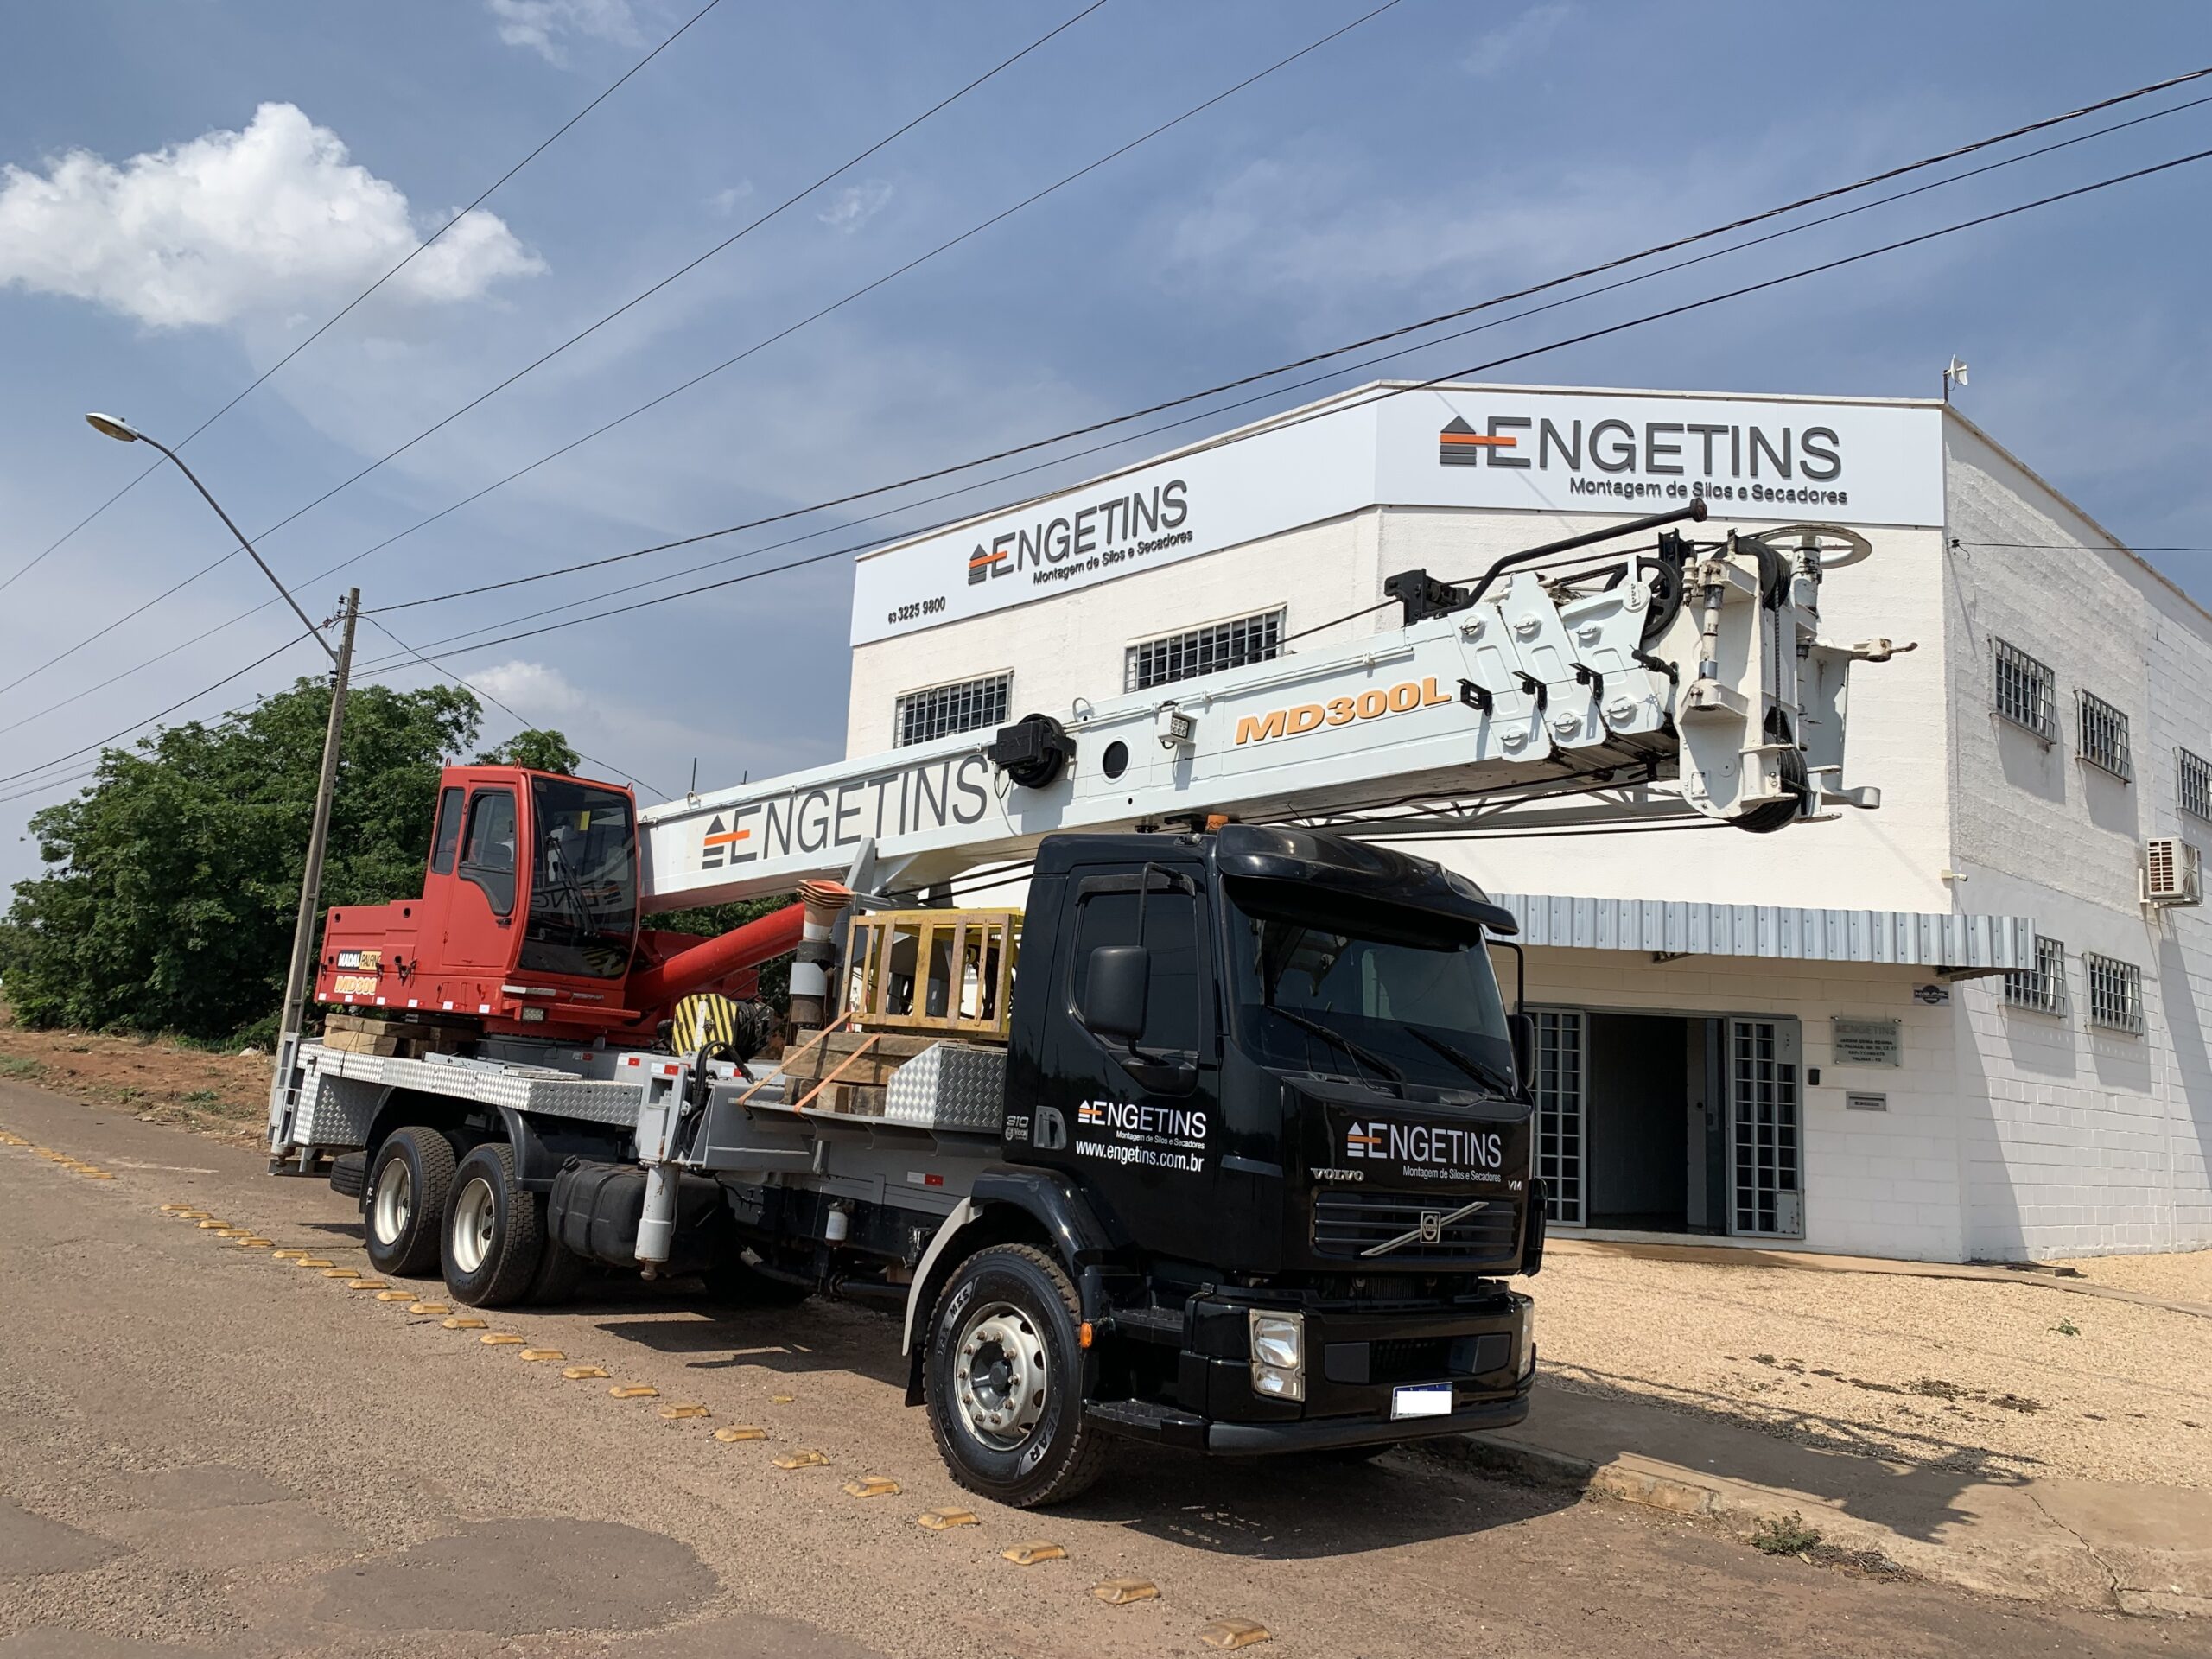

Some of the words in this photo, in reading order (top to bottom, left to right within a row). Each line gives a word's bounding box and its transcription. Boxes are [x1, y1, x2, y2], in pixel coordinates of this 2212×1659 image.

[1487, 416, 1841, 480] ENGETINS
[1569, 478, 1661, 499] Montagem
[1666, 481, 1687, 497] de
[1692, 481, 1732, 499] Silos
[1738, 486, 1748, 499] e
[1751, 484, 1848, 505] Secadores
[991, 479, 1188, 578] ENGETINS
[1033, 562, 1084, 585] Montagem
[1086, 556, 1100, 571] de
[1102, 549, 1126, 568] Silos
[1128, 547, 1135, 558] e
[1136, 530, 1193, 556] Secadores
[888, 612, 897, 624] 63
[898, 602, 920, 621] 3225
[922, 596, 945, 615] 9800
[1236, 677, 1452, 745] MD300L
[730, 754, 988, 865] ENGETINS
[1091, 1101, 1206, 1139] ENGETINS
[1076, 1141, 1205, 1172] www.engetins.com.br
[1116, 1130, 1145, 1141] Montagem
[1154, 1135, 1168, 1144] Silos
[1173, 1138, 1205, 1149] Secadores
[1368, 1122, 1502, 1168] ENGETINS
[1310, 1167, 1364, 1181] VOLVO
[1402, 1165, 1438, 1180] Montagem
[1440, 1168, 1448, 1179] de
[1449, 1168, 1464, 1179] Silos
[1471, 1170, 1502, 1182] Secadores
[1508, 1180, 1522, 1191] VM
